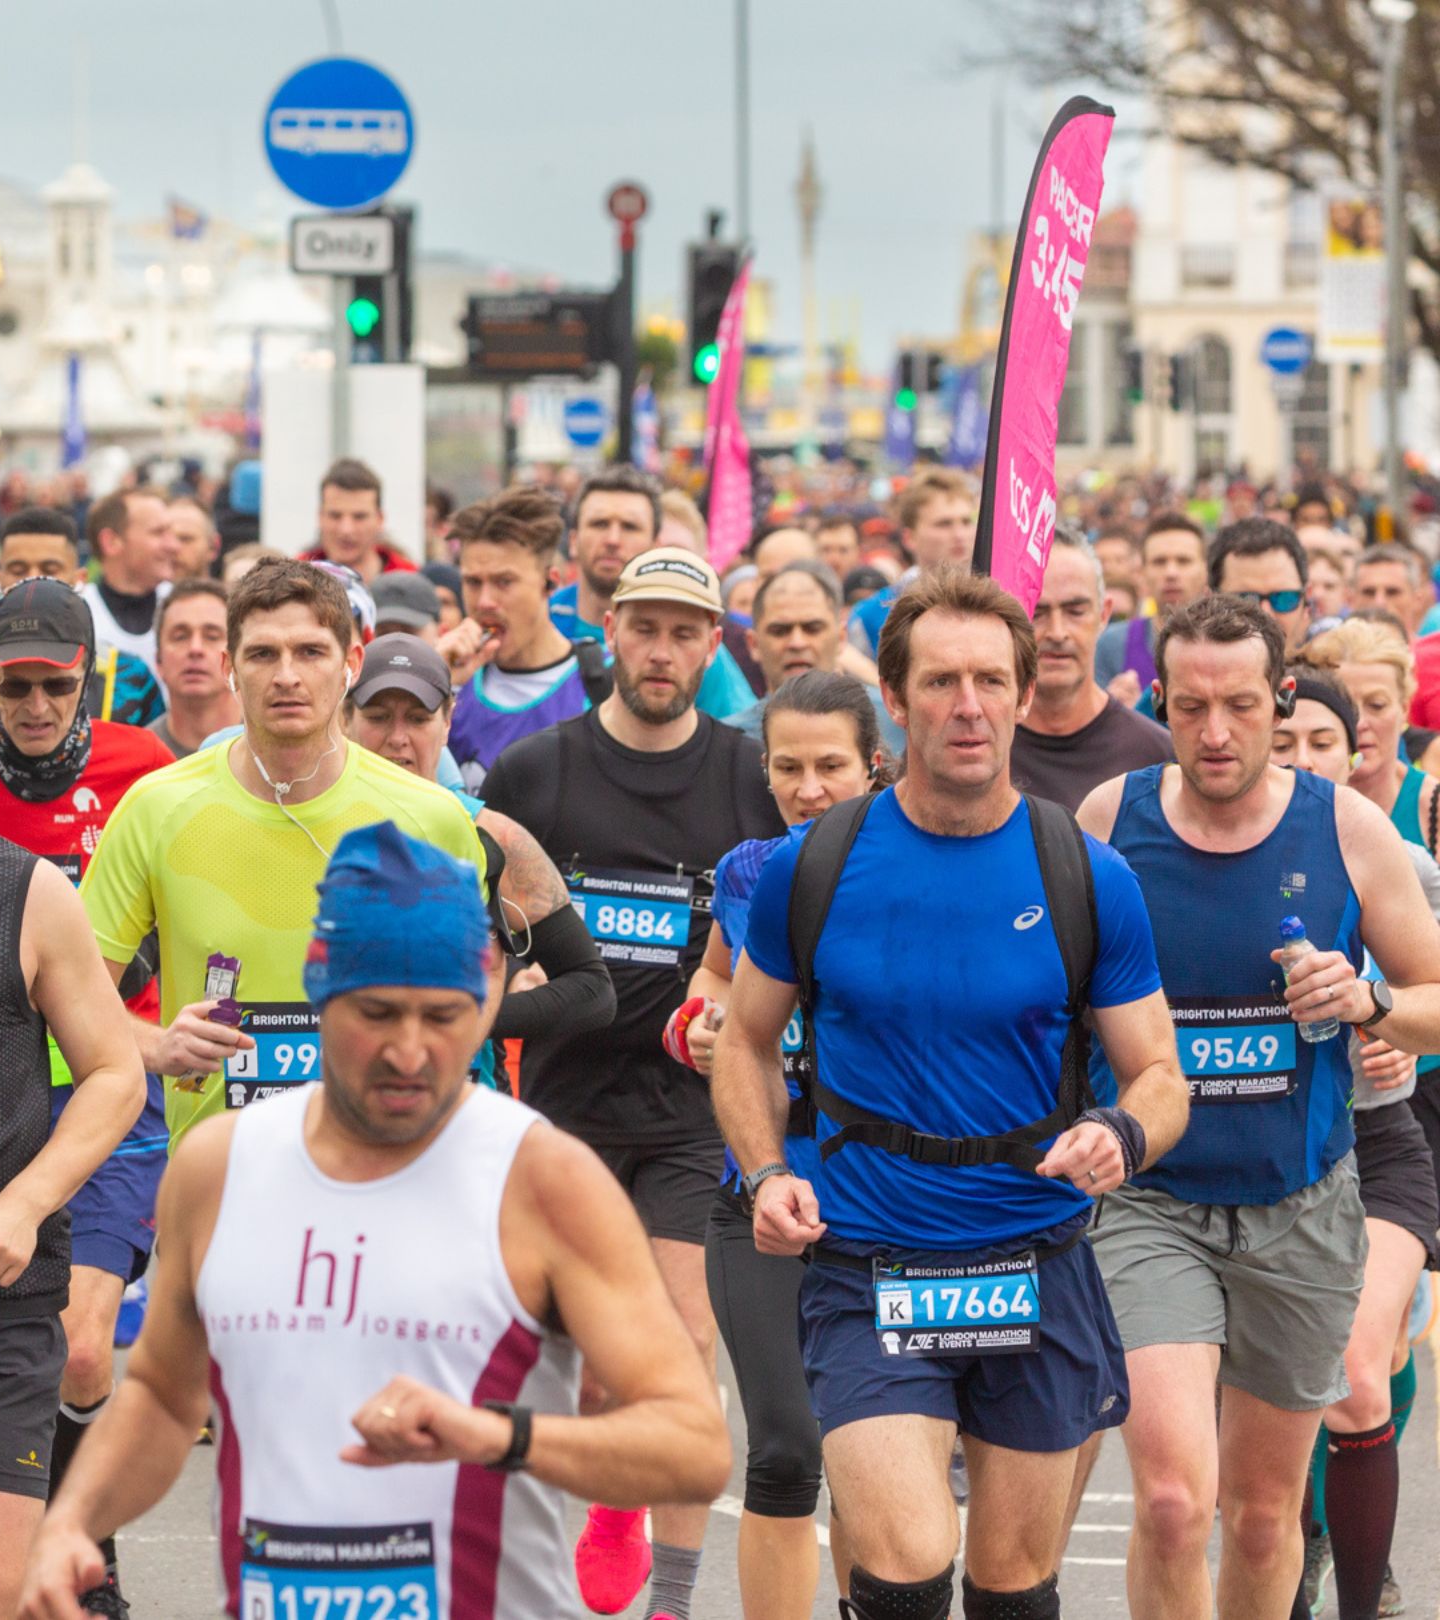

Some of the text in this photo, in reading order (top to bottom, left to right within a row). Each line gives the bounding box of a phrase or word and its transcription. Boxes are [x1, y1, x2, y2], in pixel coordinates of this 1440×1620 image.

[1049, 165, 1095, 247] PACR
[306, 229, 379, 258] Only
[1031, 215, 1086, 331] 3:45
[54, 814, 75, 823] RUN
[583, 877, 689, 898] BRIGHTON MARATHON
[597, 905, 674, 940] 8884
[252, 1014, 309, 1026] BRIGHTON
[1171, 1005, 1290, 1020] BRIGHTON MARATHON
[237, 1043, 322, 1076] J 99
[1191, 1035, 1279, 1070] 9549
[1200, 1086, 1233, 1096] EVENTS
[1201, 1079, 1238, 1088] LONDON
[1239, 1075, 1288, 1087] MARATHON
[295, 1227, 366, 1328] hj
[905, 1259, 1032, 1278] BRIGHTON MARATHON
[888, 1284, 1033, 1322] K 17664
[360, 1313, 481, 1342] joggers
[939, 1328, 1031, 1340] LONDON MARATHON
[939, 1339, 973, 1349] EVENTS
[265, 1539, 431, 1562] BRIGHTON MARATHON
[279, 1583, 431, 1620] 17723
